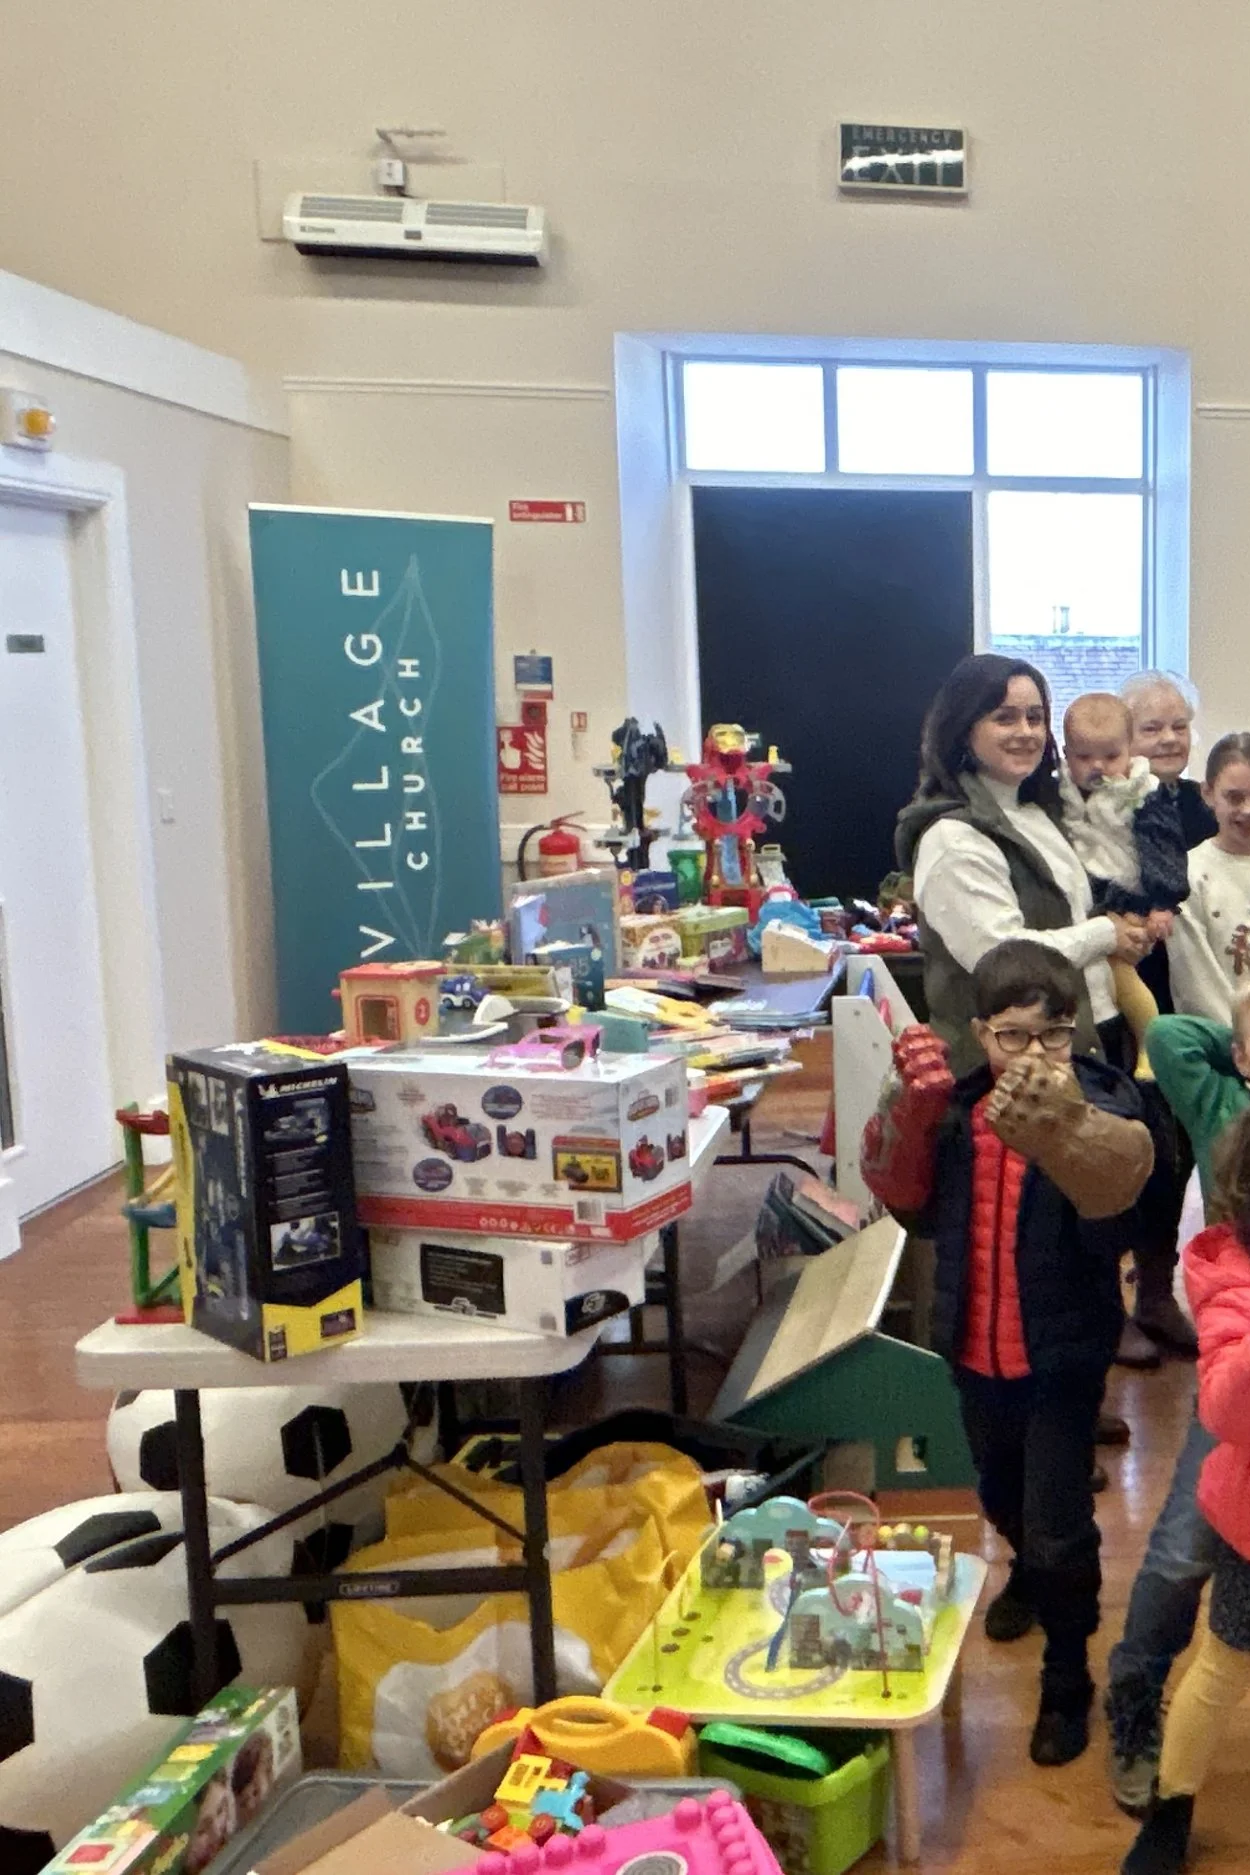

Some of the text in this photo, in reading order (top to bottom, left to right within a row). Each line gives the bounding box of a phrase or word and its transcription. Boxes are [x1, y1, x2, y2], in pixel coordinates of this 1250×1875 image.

[851, 126, 954, 144] EMERGENCY
[341, 568, 397, 958] VILLAGE
[397, 658, 429, 871] CHURCH
[279, 1076, 338, 1093] MICHELIN
